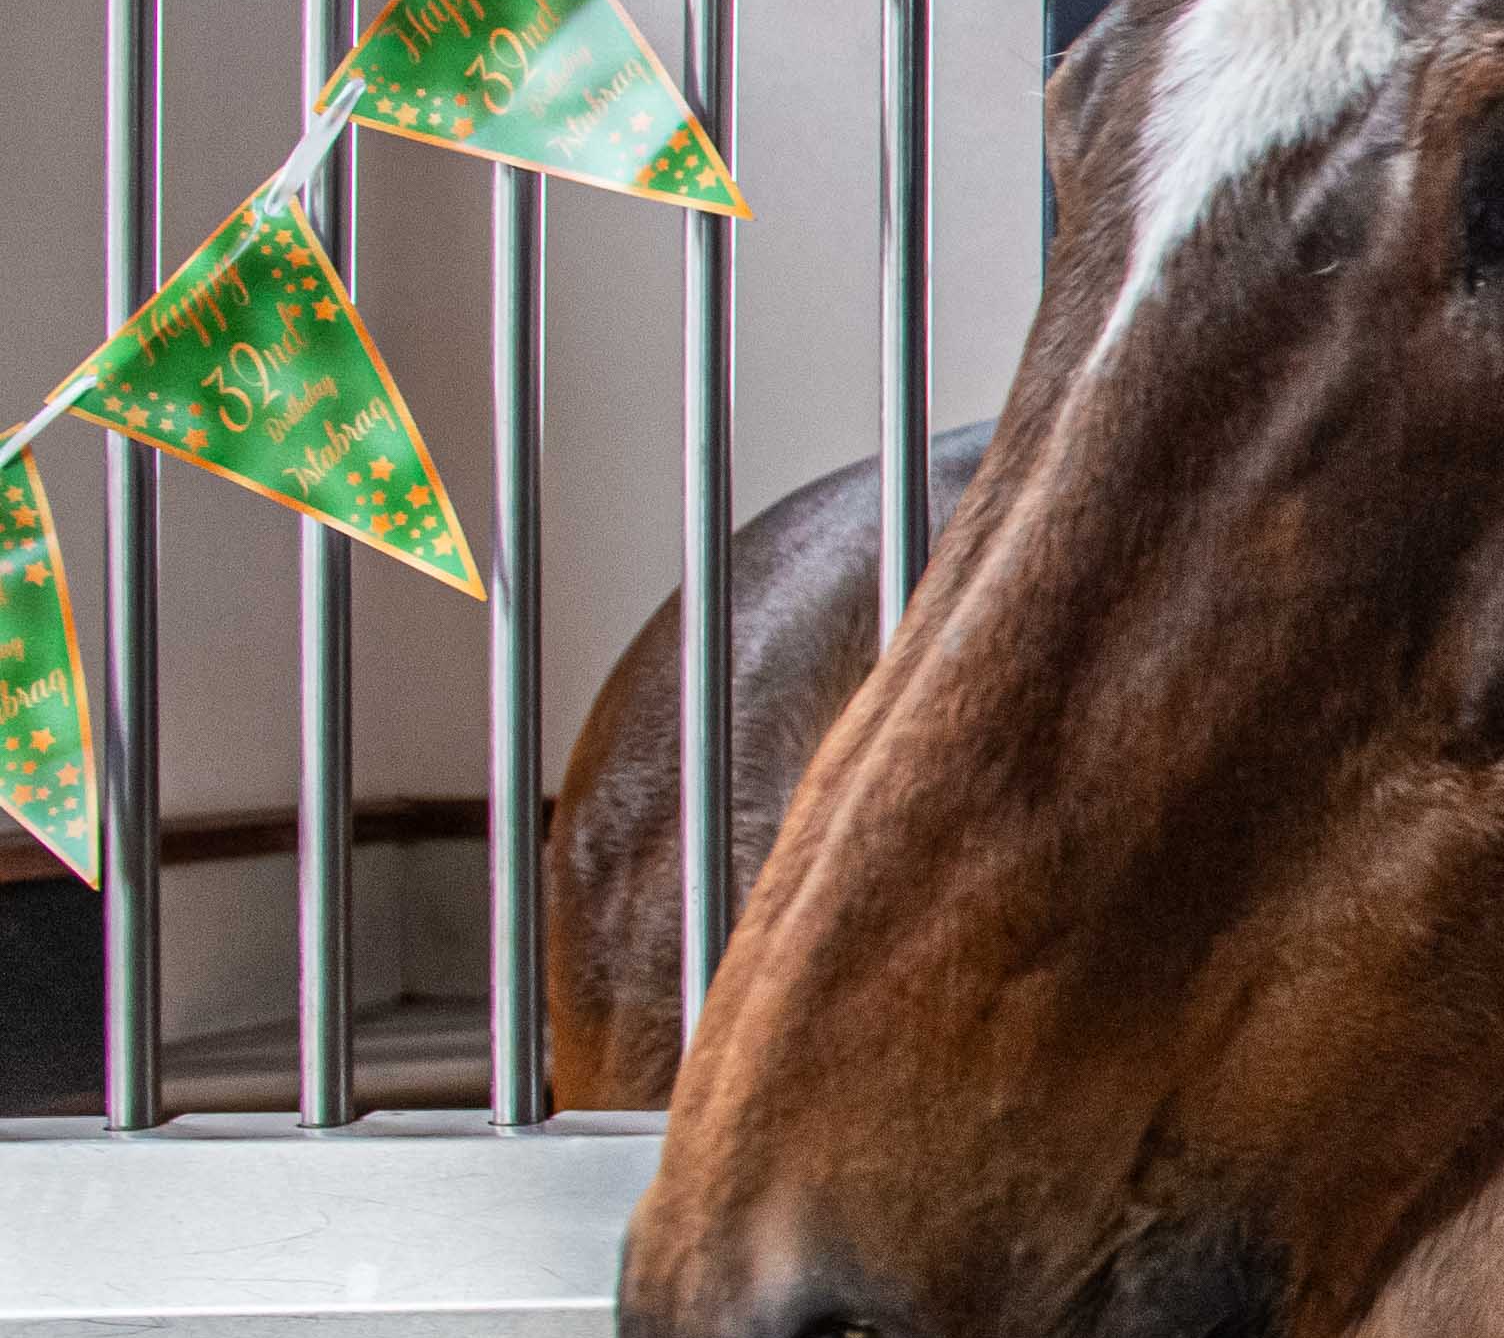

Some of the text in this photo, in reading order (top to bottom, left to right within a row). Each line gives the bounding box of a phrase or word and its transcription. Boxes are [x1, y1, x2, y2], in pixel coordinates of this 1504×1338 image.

[126, 255, 250, 363] Happy
[201, 301, 309, 432] 32nd
[283, 396, 397, 494] Istabraq
